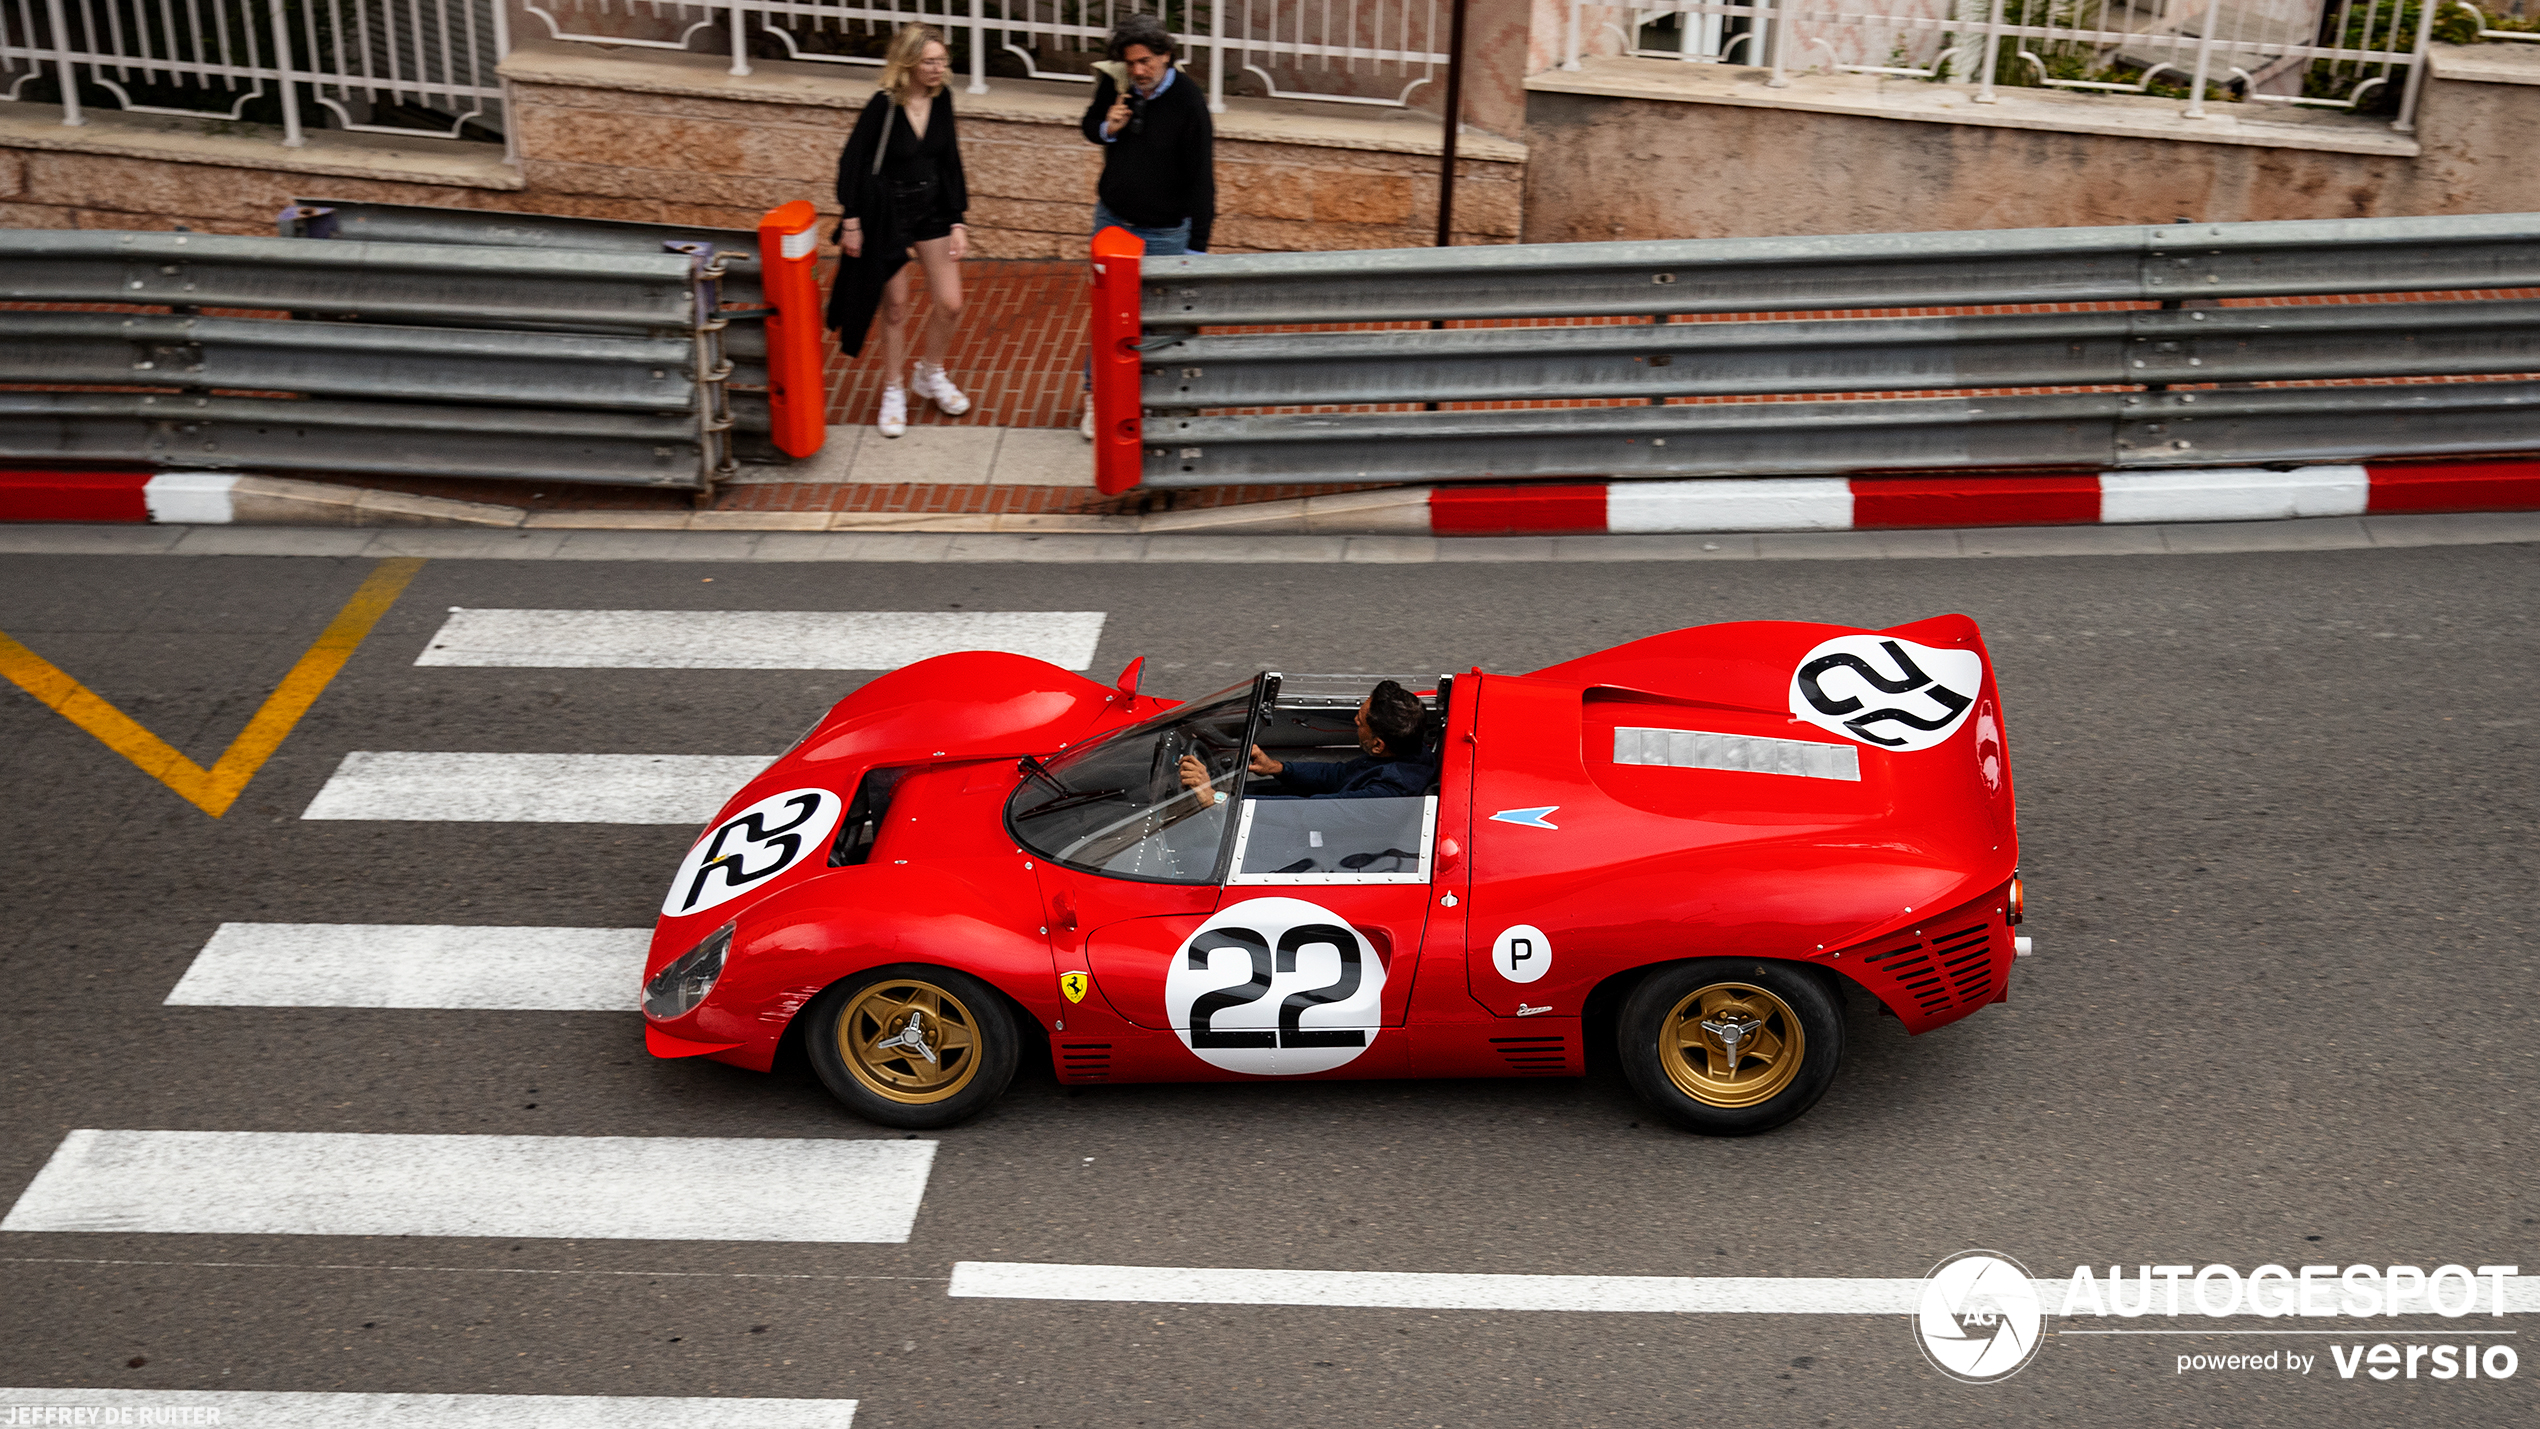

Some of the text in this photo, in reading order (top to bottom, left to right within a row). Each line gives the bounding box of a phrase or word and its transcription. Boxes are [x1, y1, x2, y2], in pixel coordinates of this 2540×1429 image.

[1798, 640, 1973, 746] 22
[681, 793, 821, 912] 22
[1188, 924, 1366, 1049] 22
[1511, 938, 1532, 971] P
